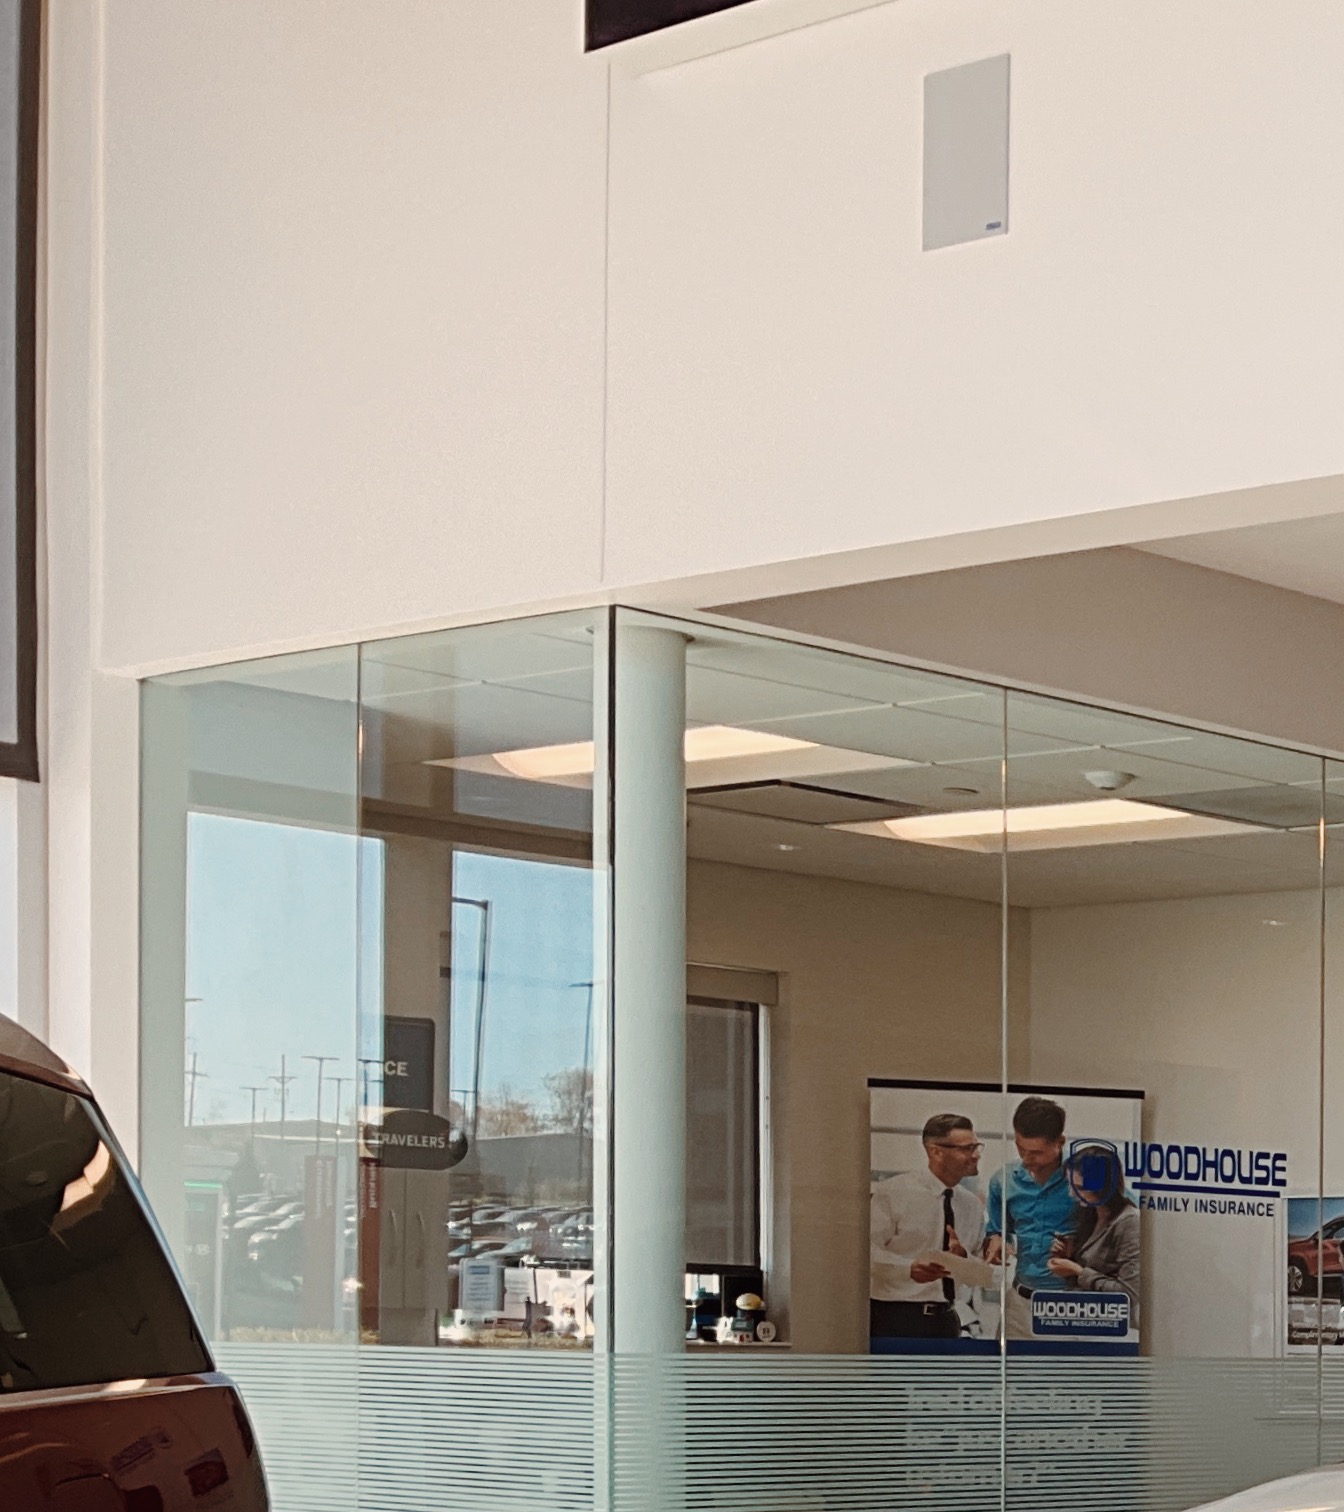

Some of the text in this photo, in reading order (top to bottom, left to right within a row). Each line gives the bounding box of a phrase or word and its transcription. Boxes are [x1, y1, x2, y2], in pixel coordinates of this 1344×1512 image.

[372, 1132, 446, 1149] TRAVELERS
[1125, 1141, 1287, 1187] WOODHOUSE
[1139, 1195, 1275, 1217] FAMILY INSURANCE
[1033, 1301, 1128, 1319] WOODHOUSE
